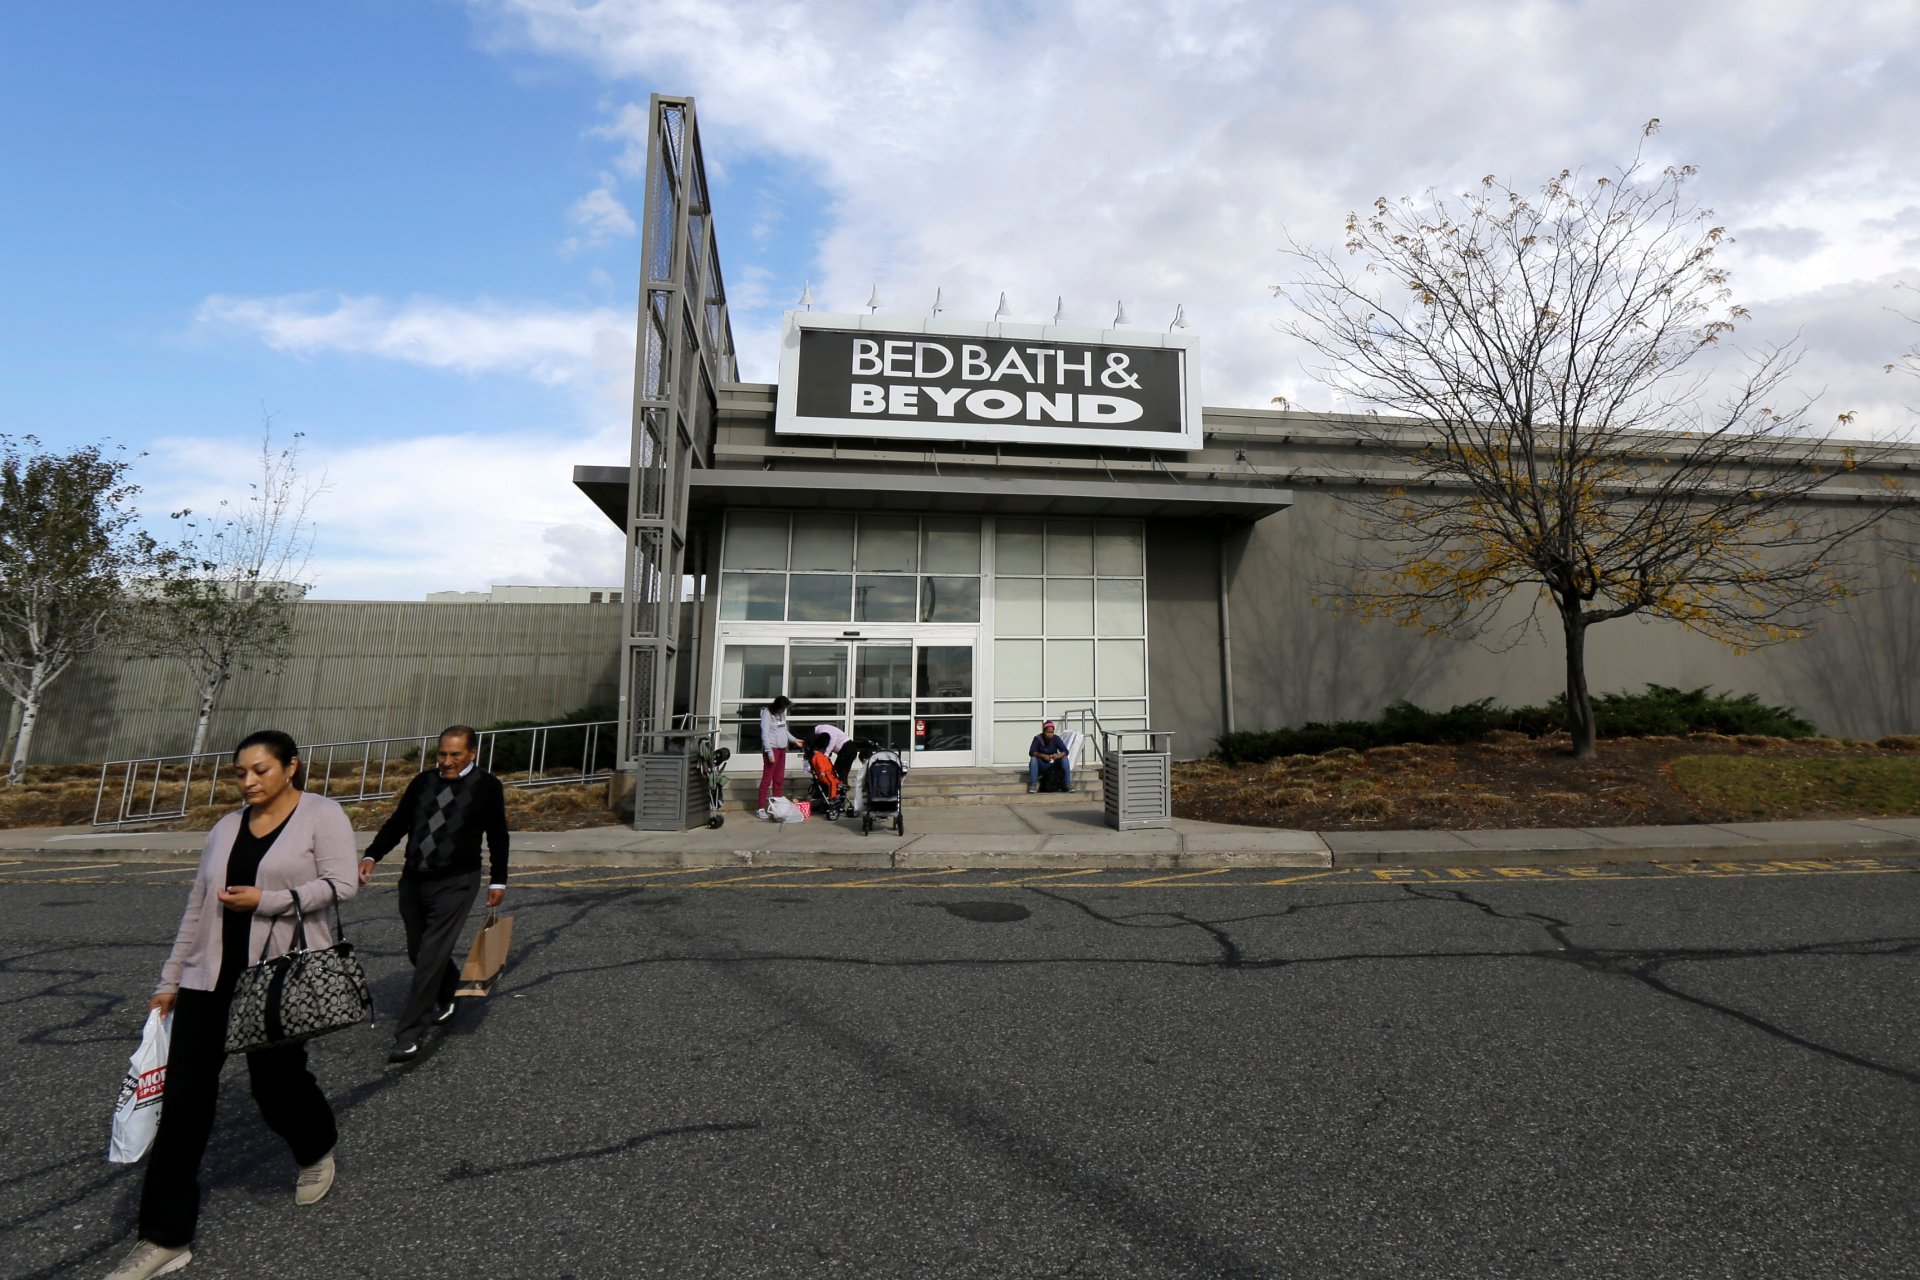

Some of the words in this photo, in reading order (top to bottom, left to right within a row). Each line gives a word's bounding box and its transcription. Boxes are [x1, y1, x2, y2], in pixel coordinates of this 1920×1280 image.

[851, 338, 954, 379] BED
[961, 344, 1092, 387] BATH
[1100, 352, 1142, 389] &
[850, 383, 1143, 424] BEYOND
